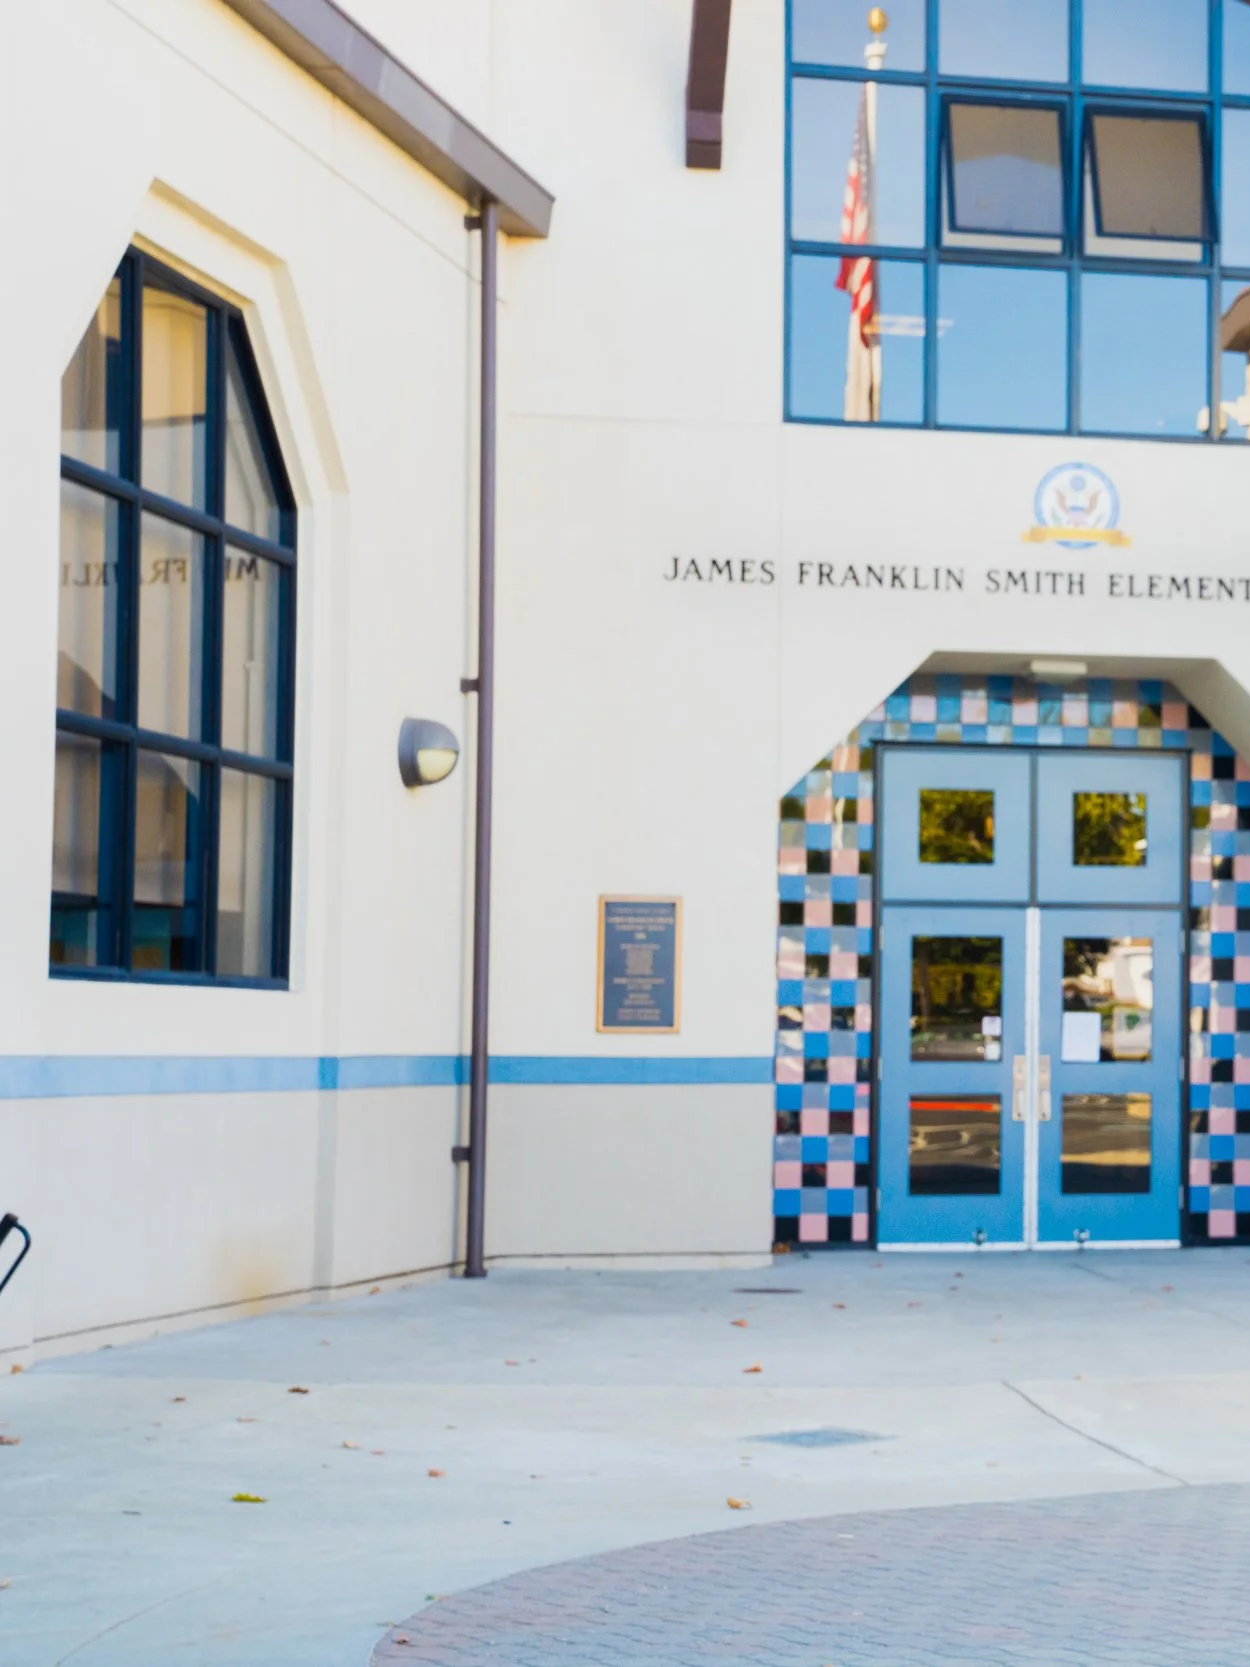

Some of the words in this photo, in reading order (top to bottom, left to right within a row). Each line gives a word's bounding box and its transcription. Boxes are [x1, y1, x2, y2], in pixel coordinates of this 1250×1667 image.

[664, 557, 776, 585] JAMES
[797, 561, 965, 592] FRANKLIN
[986, 570, 1087, 596] SMITH
